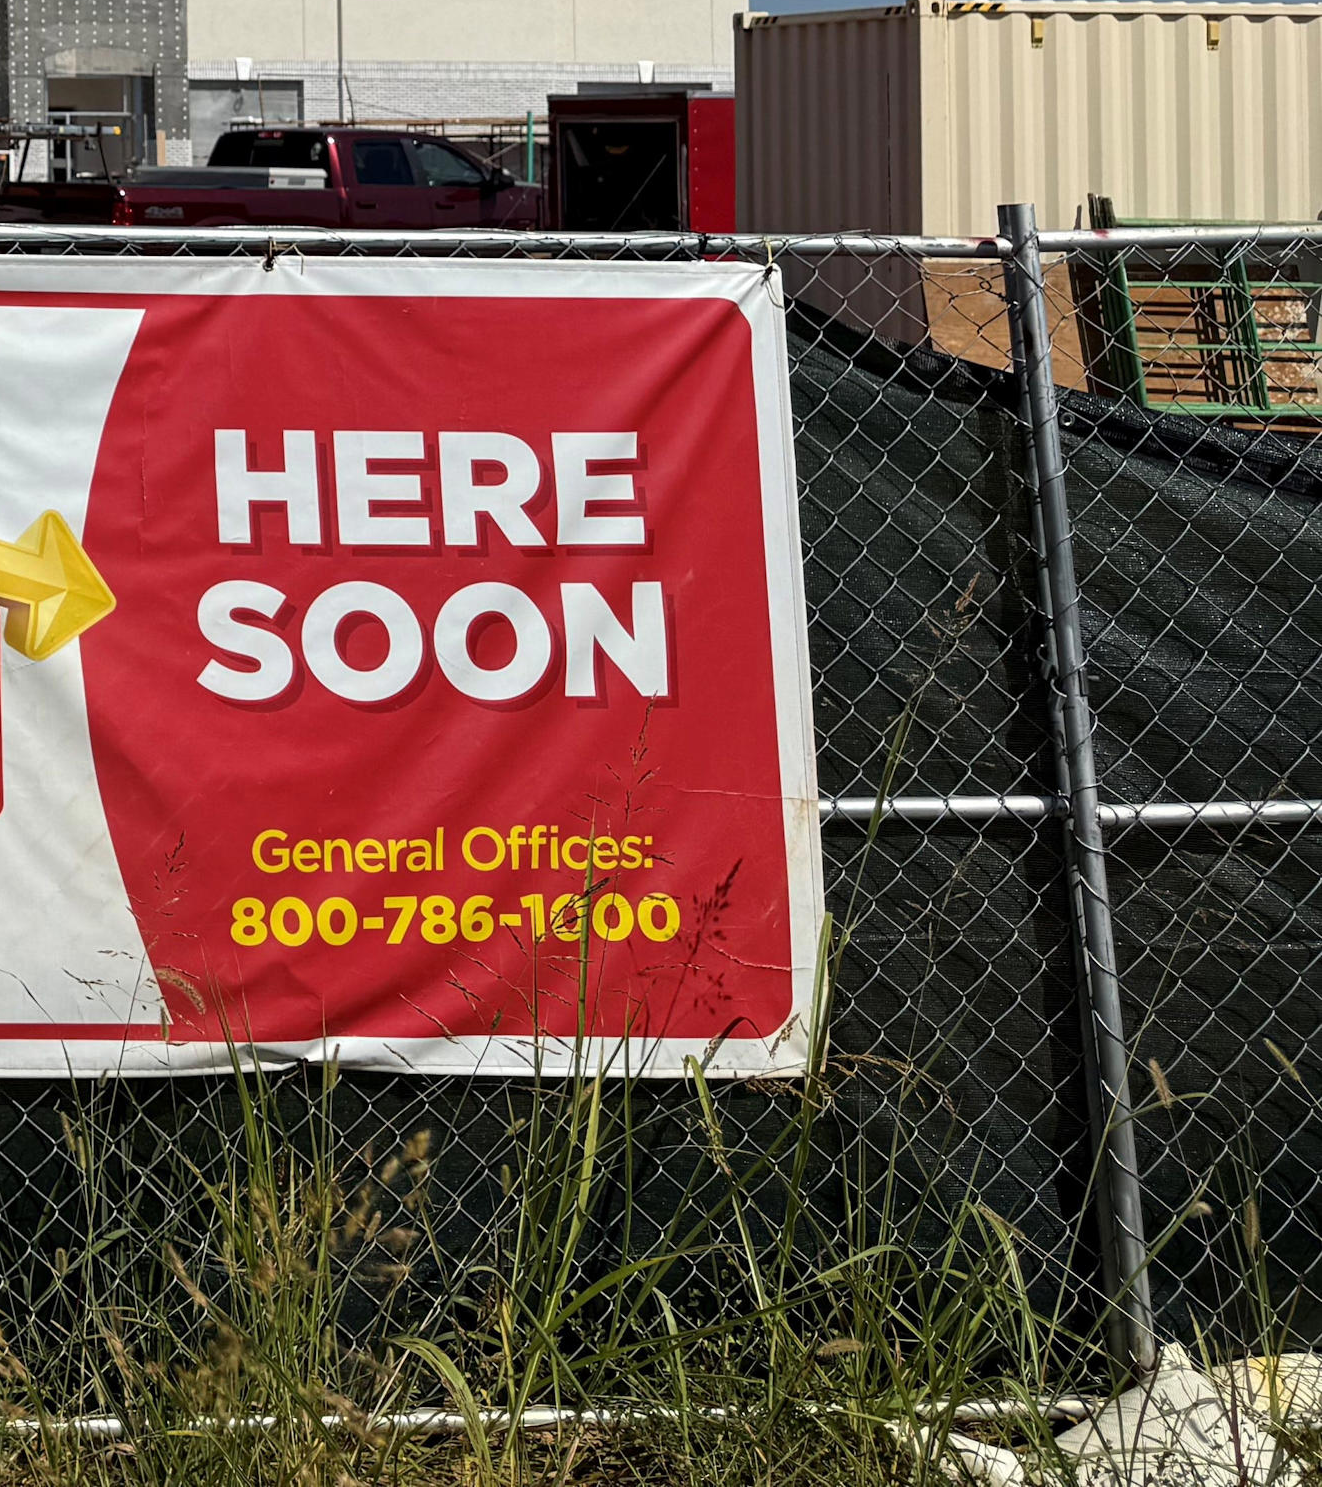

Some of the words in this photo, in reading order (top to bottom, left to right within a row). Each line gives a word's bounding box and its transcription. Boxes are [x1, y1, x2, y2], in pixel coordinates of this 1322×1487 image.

[213, 428, 646, 546] HERE
[195, 579, 669, 701] SOON
[251, 825, 445, 874] General
[461, 824, 654, 872] Offices:
[229, 891, 681, 948] 800-786-1000
